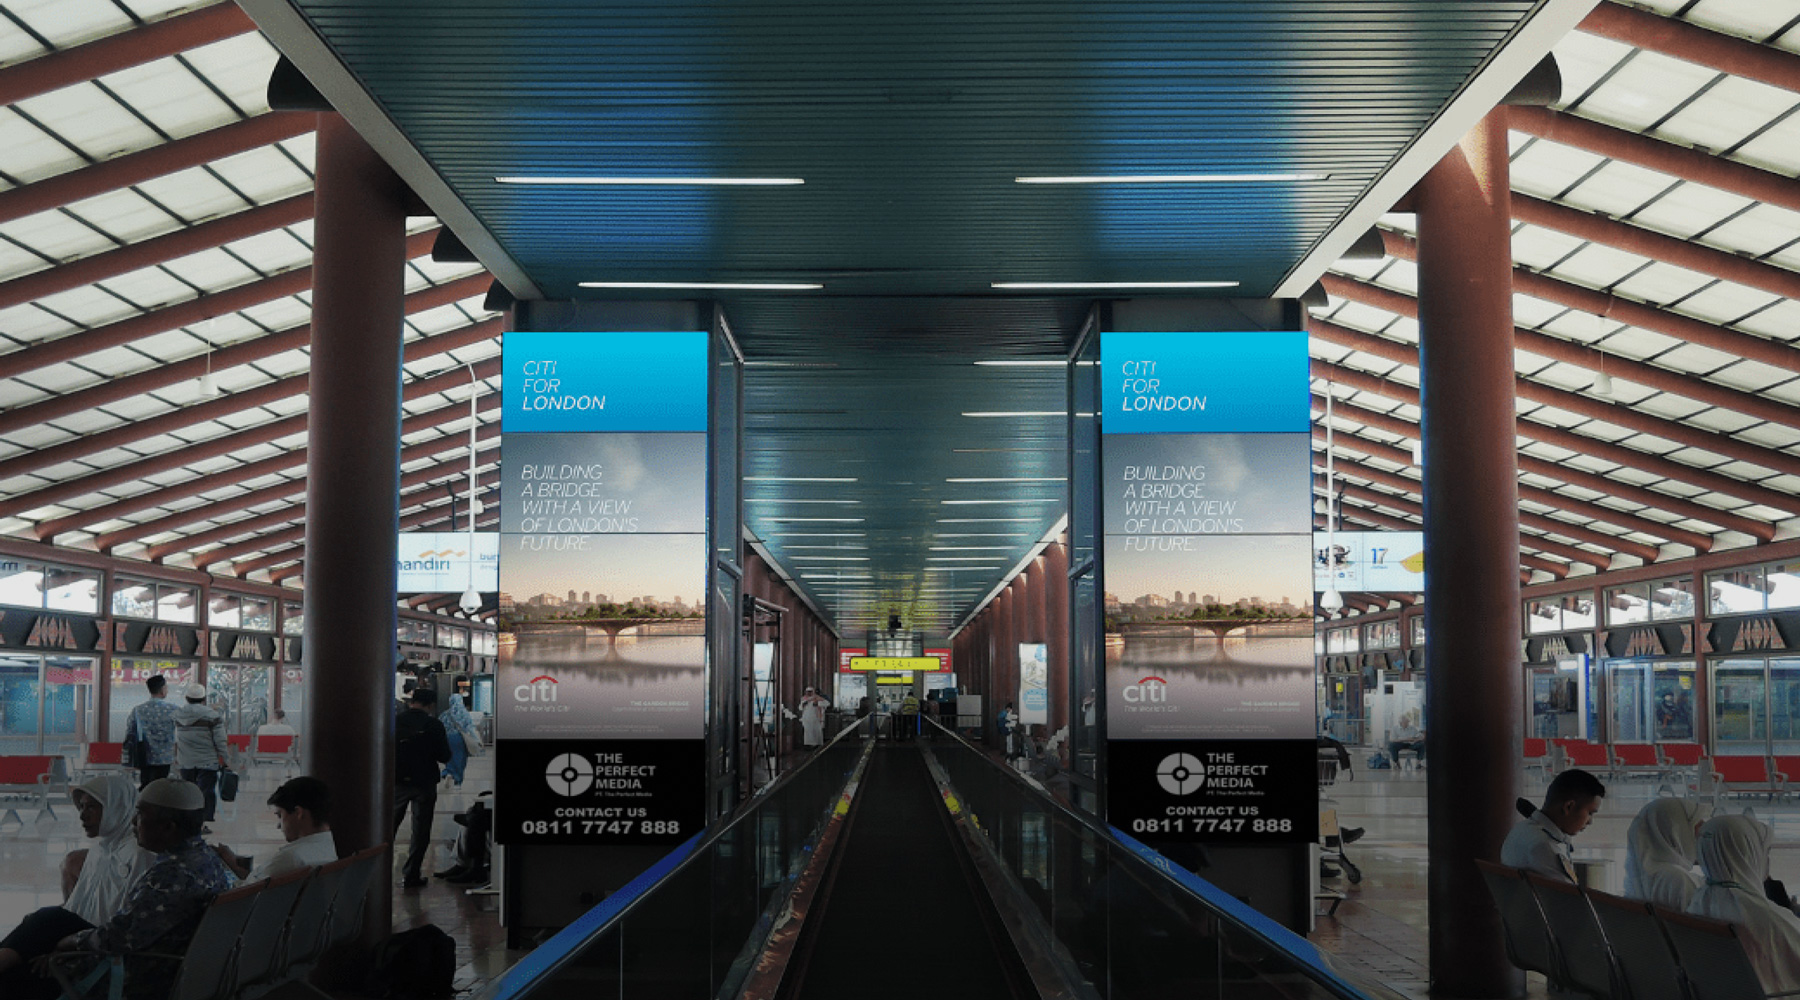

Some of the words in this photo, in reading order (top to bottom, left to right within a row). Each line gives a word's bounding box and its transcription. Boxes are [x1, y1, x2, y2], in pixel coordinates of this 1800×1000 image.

[523, 360, 557, 375] CITI
[1122, 360, 1157, 376] CITI
[523, 379, 561, 393] FOR
[1123, 379, 1160, 394] FOR
[522, 395, 606, 410] LONDON
[1122, 396, 1207, 411] LONDON
[521, 464, 603, 480] BUILDING
[1123, 466, 1206, 481] BUILDING
[521, 483, 533, 497] A
[537, 482, 603, 497] BRIDGE
[1123, 484, 1136, 499] A
[1140, 483, 1206, 499] BRIDGE
[522, 500, 567, 515] WITH
[569, 500, 582, 515] A
[588, 500, 632, 515] VIEW
[1125, 501, 1170, 516] WITH
[1173, 501, 1186, 515] A
[1191, 501, 1237, 516] VIEW
[521, 518, 547, 533] OF
[549, 517, 639, 533] LONDON'S
[1124, 519, 1151, 534] OF
[1152, 519, 1244, 534] LONDON'S
[1124, 536, 1197, 552] FUTURE.
[1371, 548, 1388, 564] 17
[595, 753, 623, 763] THE
[1207, 752, 1235, 763] THE
[595, 765, 656, 776] PERFECT
[1207, 765, 1269, 776] PERFECT
[595, 778, 642, 789] MEDIA
[1207, 777, 1254, 788] MEDIA
[555, 807, 623, 818] CONTACT
[627, 807, 647, 818] US
[1166, 806, 1235, 816] CONTACT
[1239, 806, 1259, 816] US
[522, 820, 573, 834] 0811
[581, 820, 634, 834] 7747
[640, 820, 680, 834] 888
[1133, 819, 1184, 833] 0811
[1192, 819, 1245, 833] 7747
[1252, 819, 1293, 833] 888
